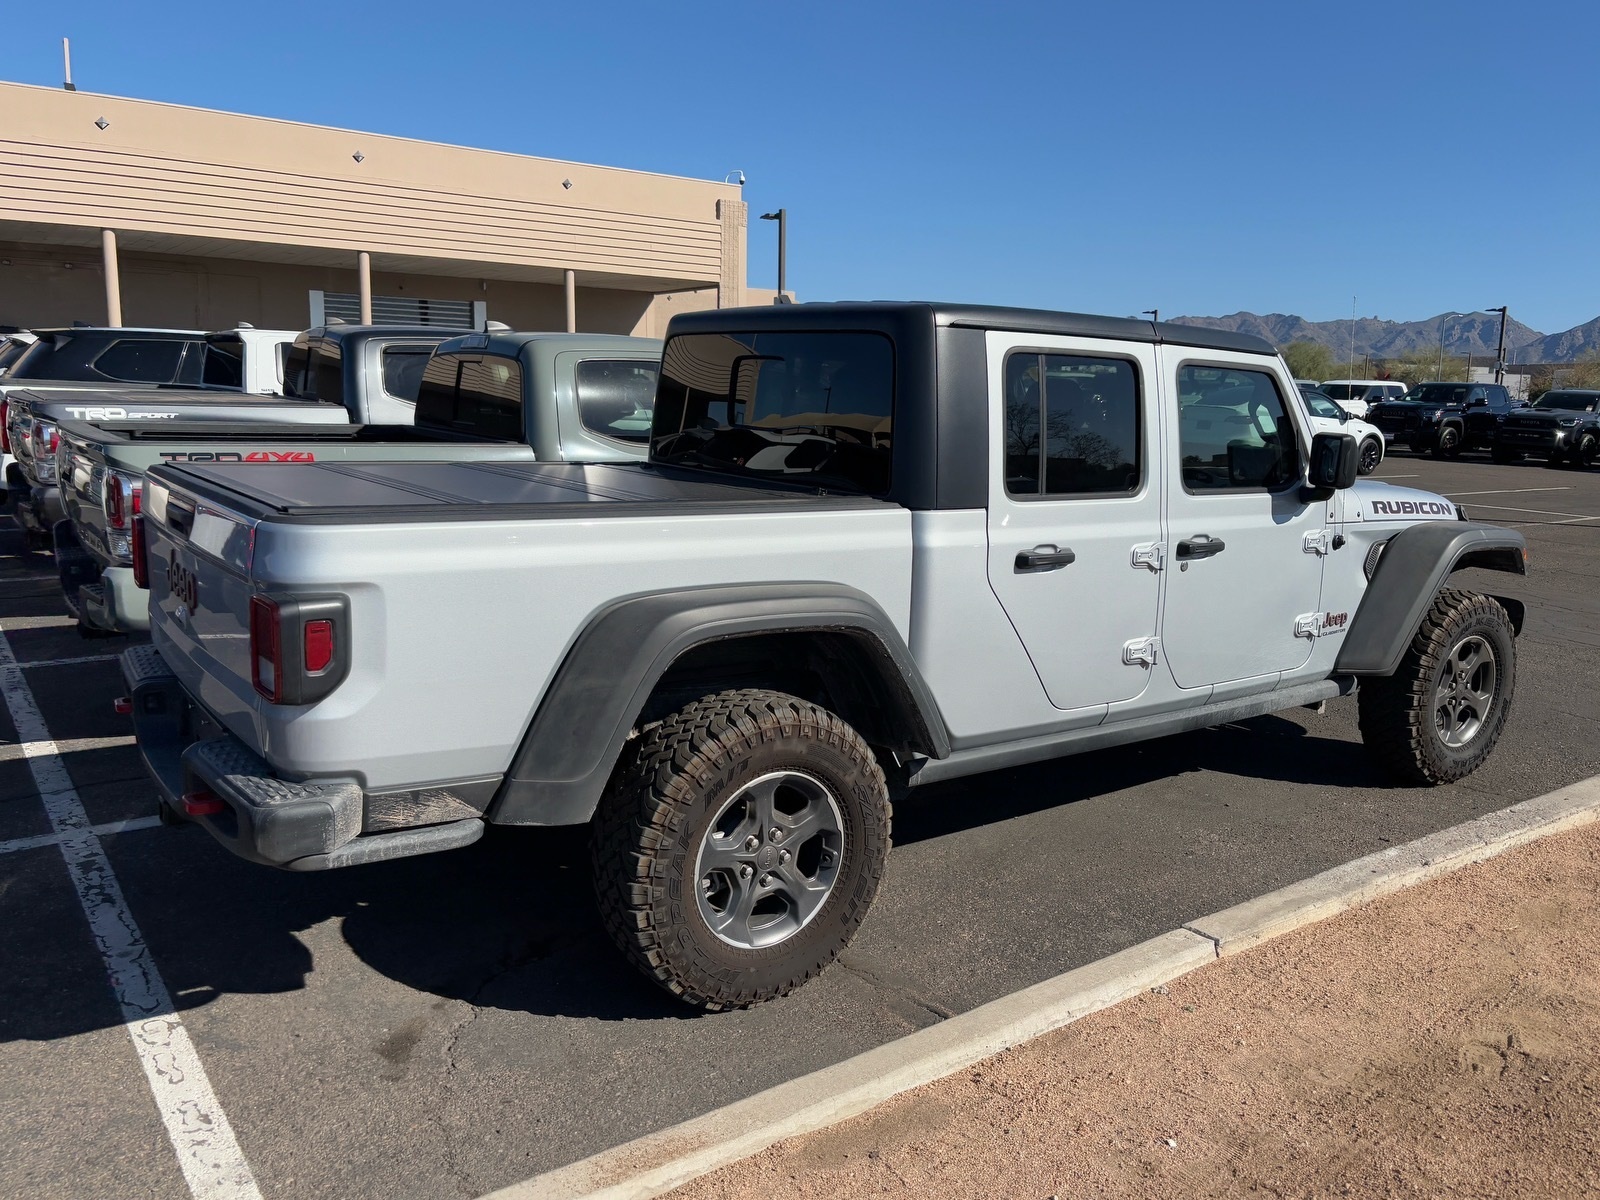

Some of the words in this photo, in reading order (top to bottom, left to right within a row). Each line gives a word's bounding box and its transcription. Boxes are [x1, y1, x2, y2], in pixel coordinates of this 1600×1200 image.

[65, 407, 128, 421] TRD
[1371, 501, 1452, 515] RUBICON
[167, 549, 198, 616] Jeep
[1322, 612, 1348, 628] Jeep
